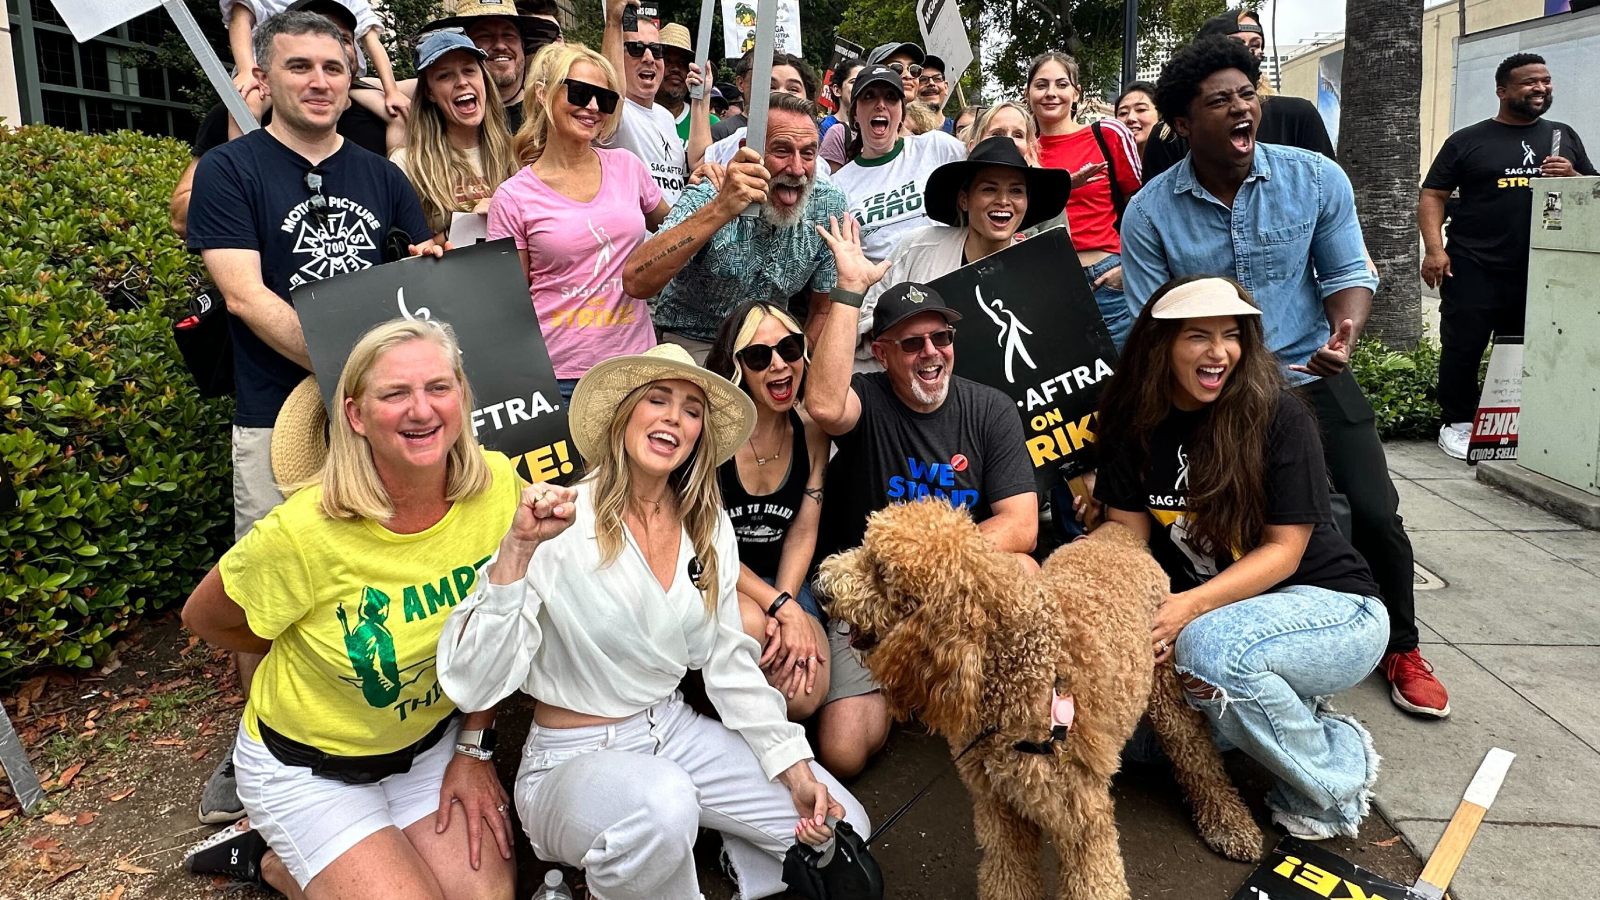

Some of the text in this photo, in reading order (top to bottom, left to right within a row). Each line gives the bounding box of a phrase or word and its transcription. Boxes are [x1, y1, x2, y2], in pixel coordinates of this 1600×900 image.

[863, 180, 915, 208] TEAM
[1497, 177, 1529, 188] STR
[328, 196, 381, 231] PICTURE
[854, 193, 926, 227] ARRO
[324, 241, 345, 255] 700
[1030, 407, 1064, 432] ON
[1025, 410, 1100, 468] RIK
[1470, 447, 1495, 461] GUILD
[907, 456, 956, 487] WE
[886, 475, 979, 510] STAND
[747, 503, 760, 514] YU
[764, 503, 793, 520] ISLAND
[394, 679, 443, 722] THI
